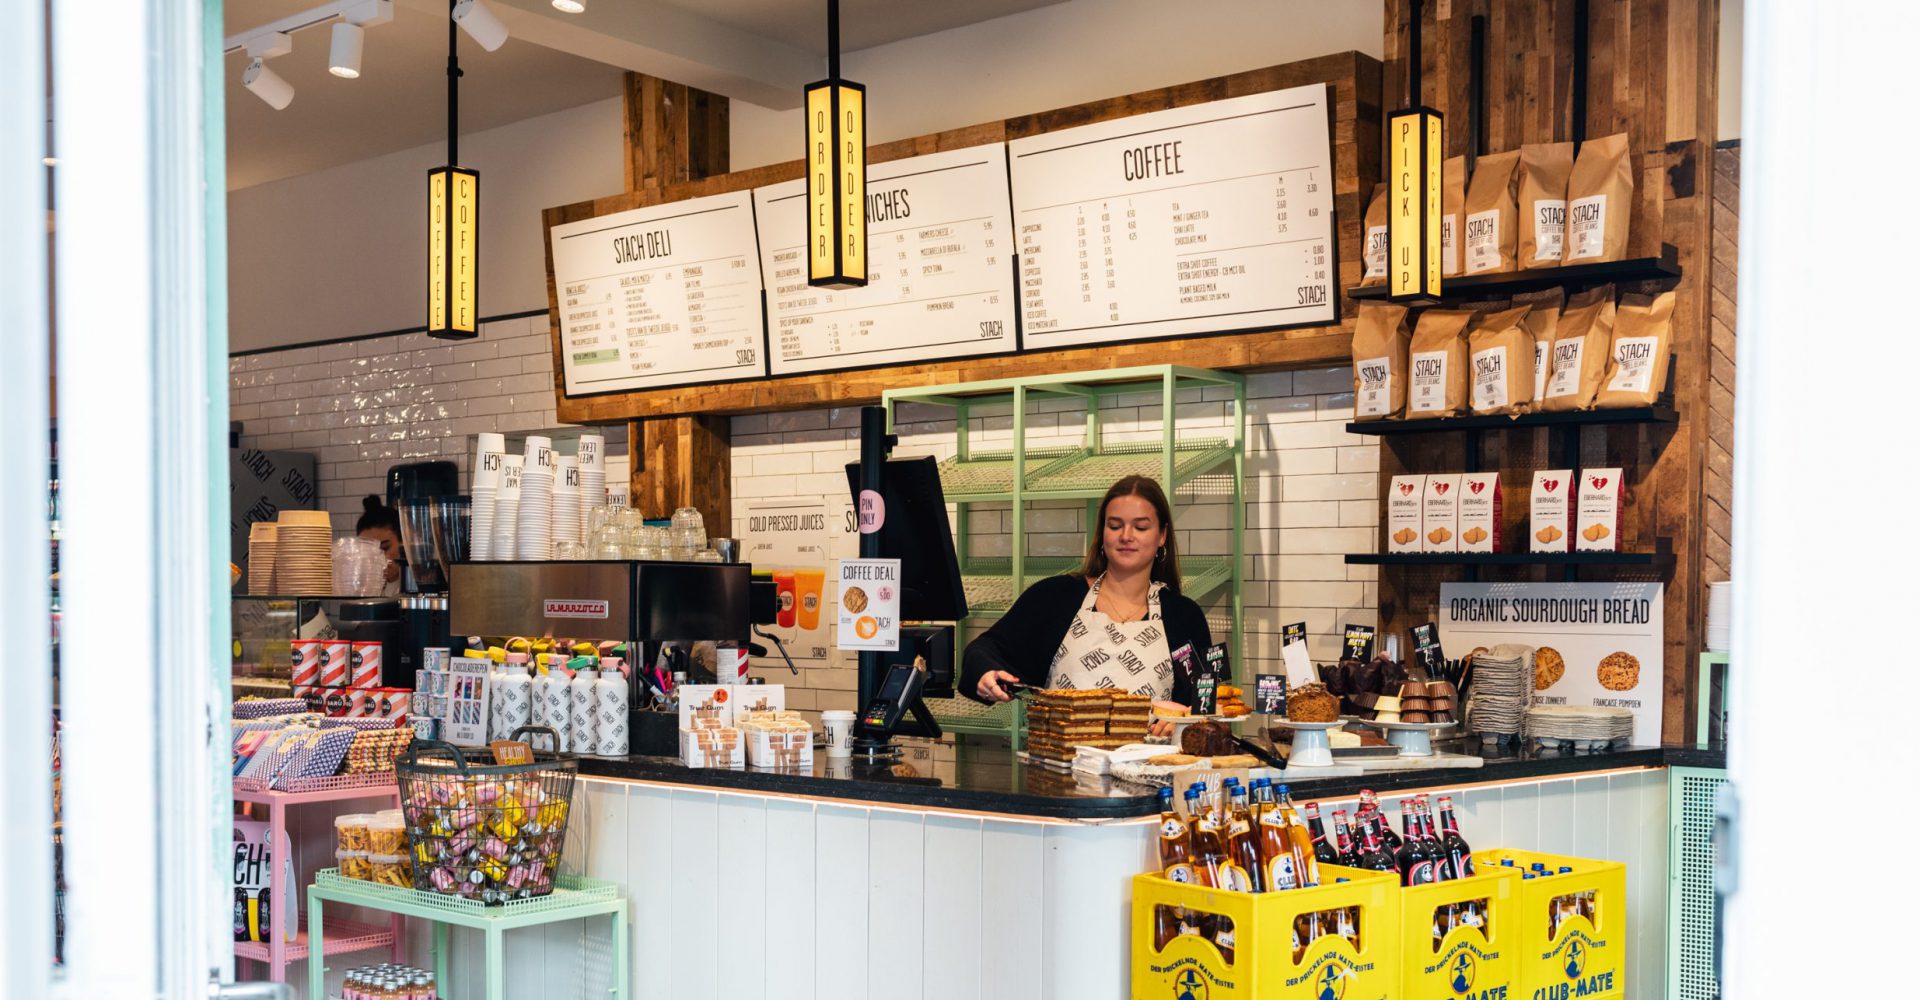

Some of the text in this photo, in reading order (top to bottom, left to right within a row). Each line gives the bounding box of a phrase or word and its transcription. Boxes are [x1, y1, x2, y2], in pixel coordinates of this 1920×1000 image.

[1123, 140, 1184, 181] COFFEE
[817, 110, 826, 257] ORDER
[847, 110, 855, 257] ORDER
[866, 188, 912, 224] ICHES
[1572, 202, 1600, 226] STACH
[1372, 231, 1389, 250] STA
[1467, 217, 1495, 243] STACH
[613, 229, 672, 264] STACH DELI
[1177, 260, 1190, 271] EXTRA
[1190, 259, 1201, 270] SHOT
[1201, 257, 1218, 268] COFFEE
[1178, 271, 1191, 281] EXTRA
[1191, 269, 1202, 280] SHOT
[1203, 268, 1219, 278] ENERGY
[1402, 246, 1409, 291] UP
[1179, 285, 1194, 295] PLANT
[1194, 284, 1206, 294] BASED
[1206, 282, 1217, 292] MILK
[1297, 284, 1327, 305] STACH
[979, 319, 1004, 338] STACH
[735, 347, 756, 365] STACH
[1554, 342, 1580, 364] STACH
[1619, 343, 1651, 363] STACH
[1362, 365, 1387, 385] STACH
[1415, 358, 1443, 378] STACH
[1475, 354, 1502, 378] STACH
[240, 446, 276, 482] STACH
[282, 467, 314, 505] STACH
[861, 498, 873, 511] PIN
[749, 512, 825, 533] COLD PRESSED JUICES
[842, 565, 896, 581] COFFEE DEAL
[875, 616, 891, 629] TACH
[1450, 597, 1651, 625] ORGANIC SOURDOUGH BREAD
[1104, 621, 1129, 647] STACH
[1133, 624, 1162, 649] STACH
[1080, 646, 1111, 672] STACH
[1117, 649, 1147, 677] STACH
[1619, 698, 1641, 709] POMPOEN
[1151, 964, 1163, 973] DER
[1286, 977, 1299, 987] DER
[1299, 951, 1337, 984] PRICKELNDE
[1533, 970, 1614, 1000] CLUB-MATE
